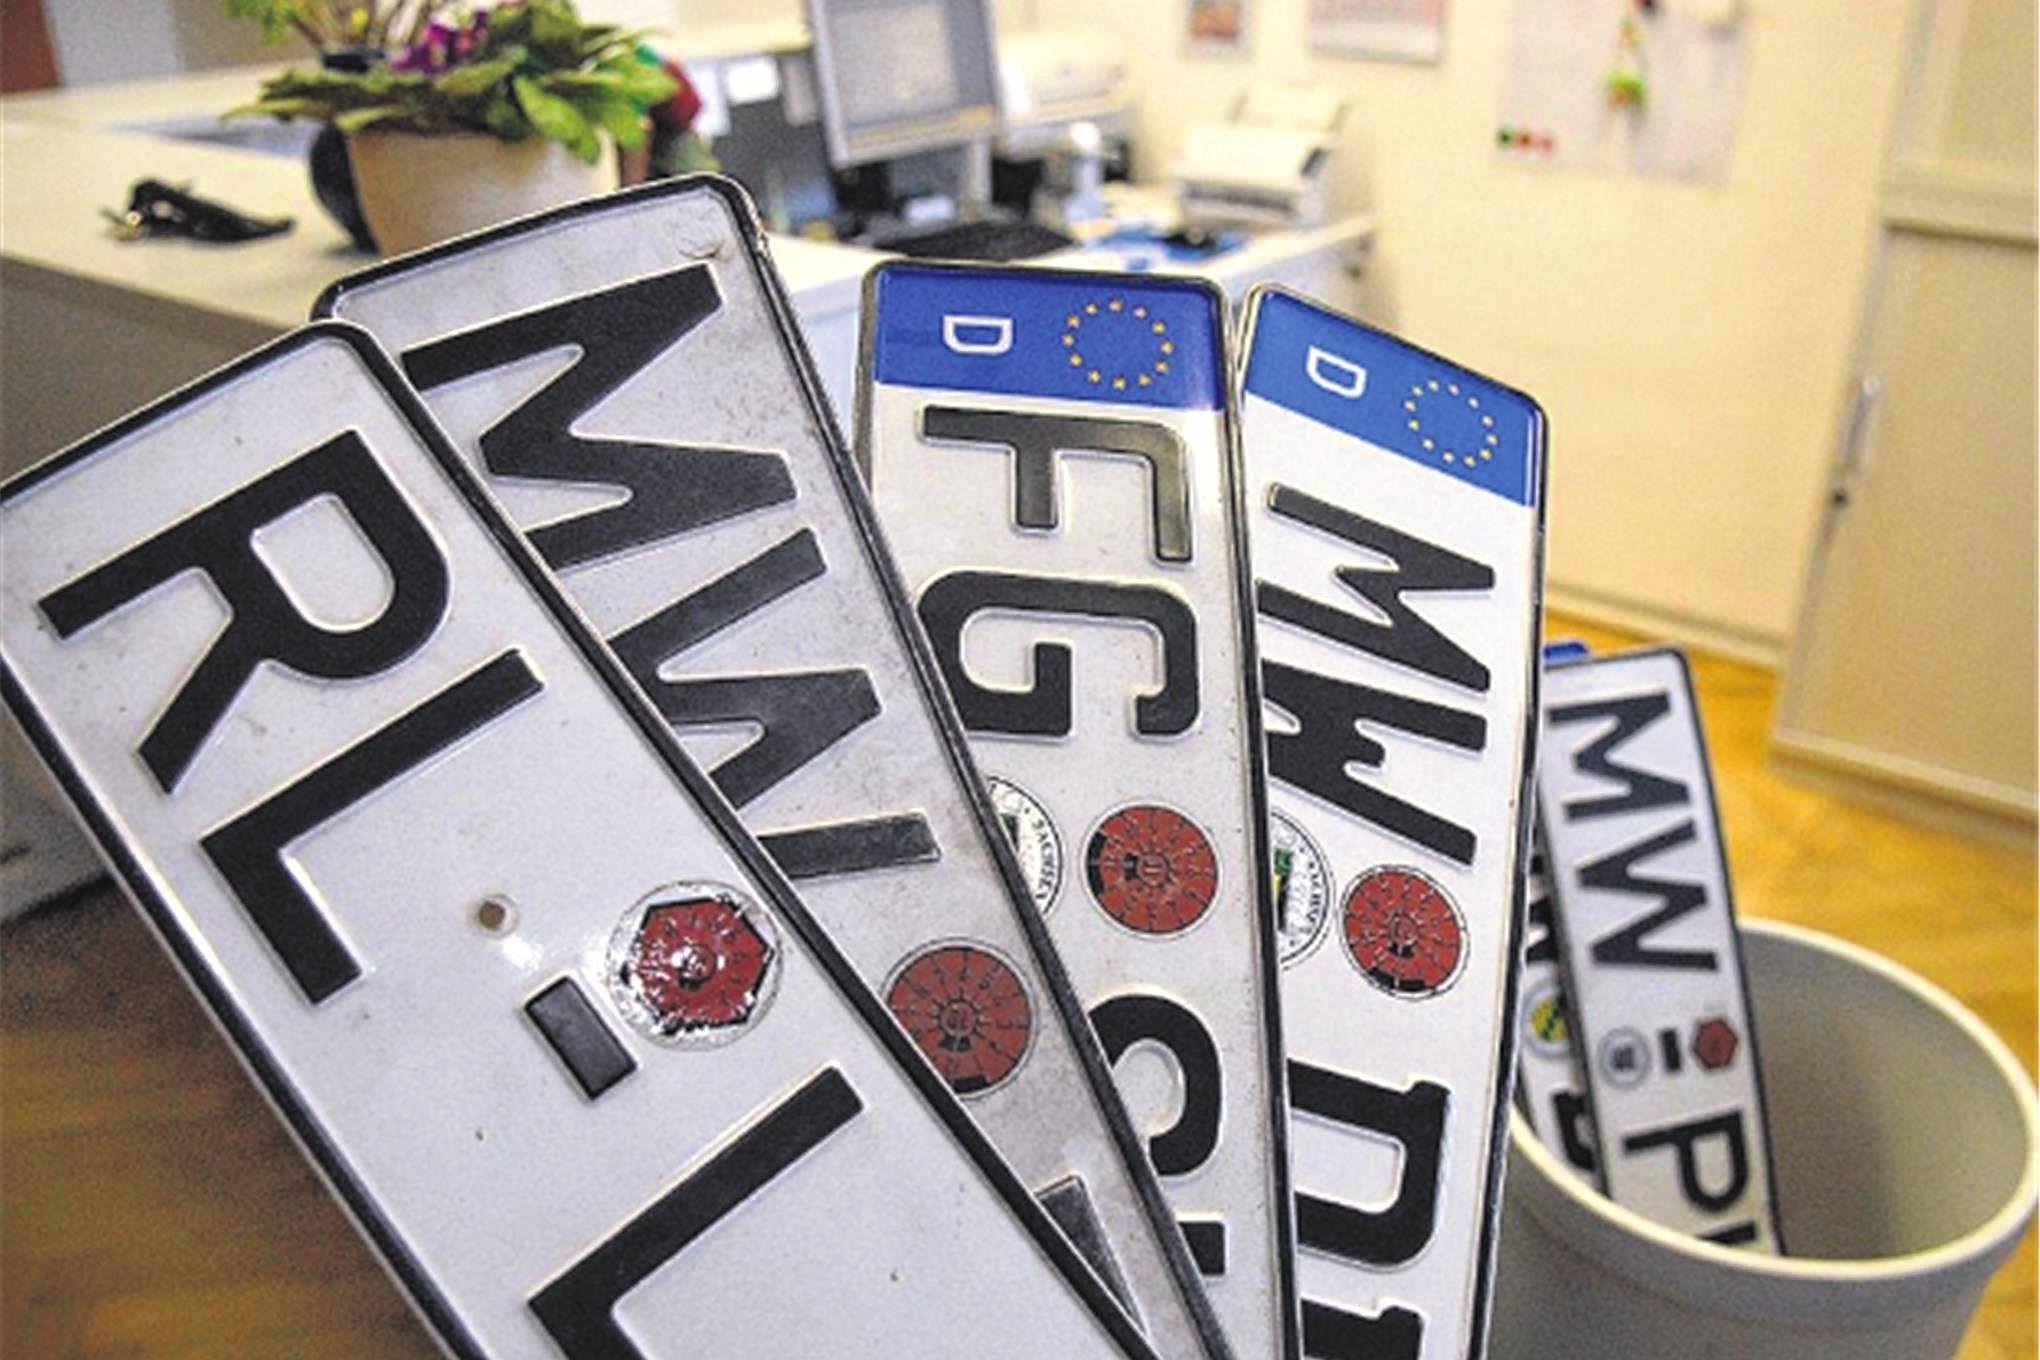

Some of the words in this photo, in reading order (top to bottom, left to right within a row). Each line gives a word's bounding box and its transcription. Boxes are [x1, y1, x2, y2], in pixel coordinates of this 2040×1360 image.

[943, 315, 1013, 354] D
[1306, 345, 1367, 398] D
[917, 403, 1199, 737] FG
